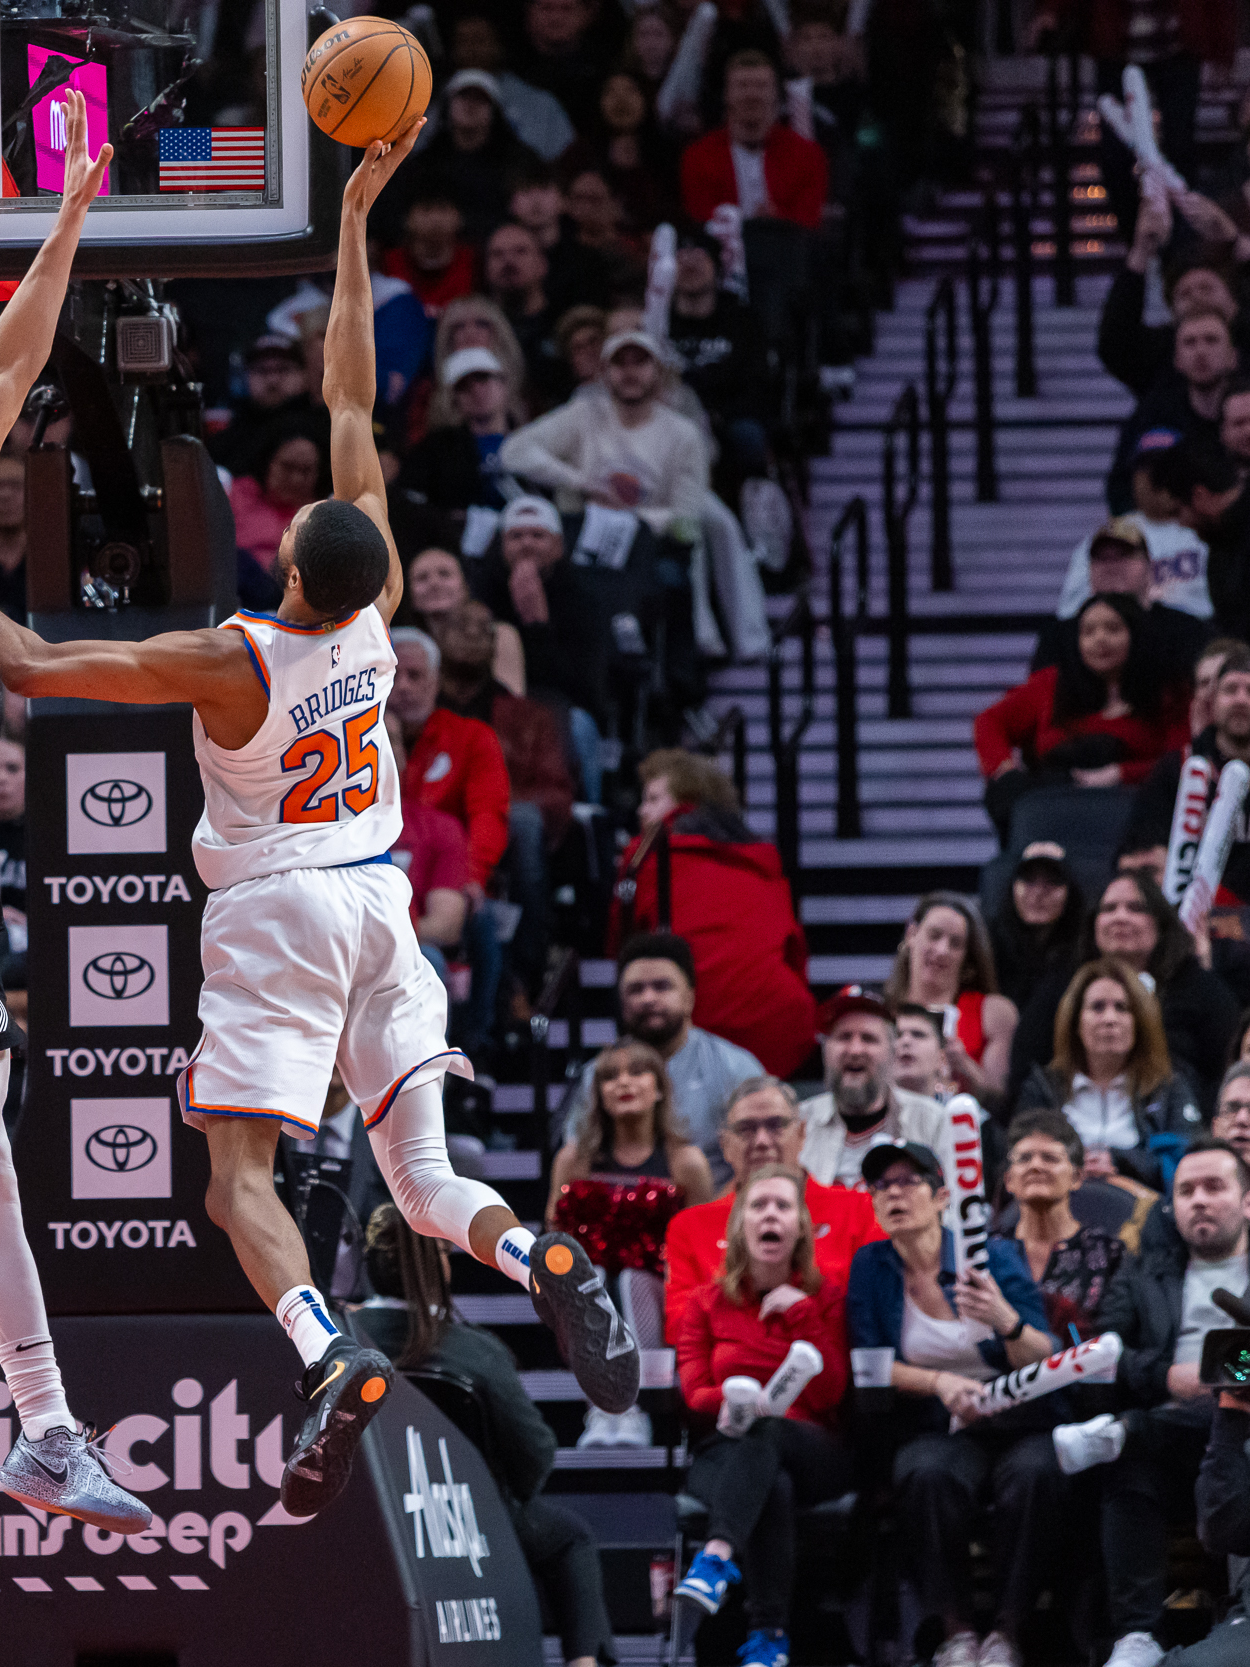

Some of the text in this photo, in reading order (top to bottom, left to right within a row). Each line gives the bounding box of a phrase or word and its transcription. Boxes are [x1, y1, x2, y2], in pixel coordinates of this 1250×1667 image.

[288, 666, 378, 735] BRIDGES
[279, 700, 382, 824] 25
[43, 874, 192, 905] TOYOTA
[45, 1046, 189, 1077] TOYOTA
[47, 1219, 198, 1250] TOYOTA
